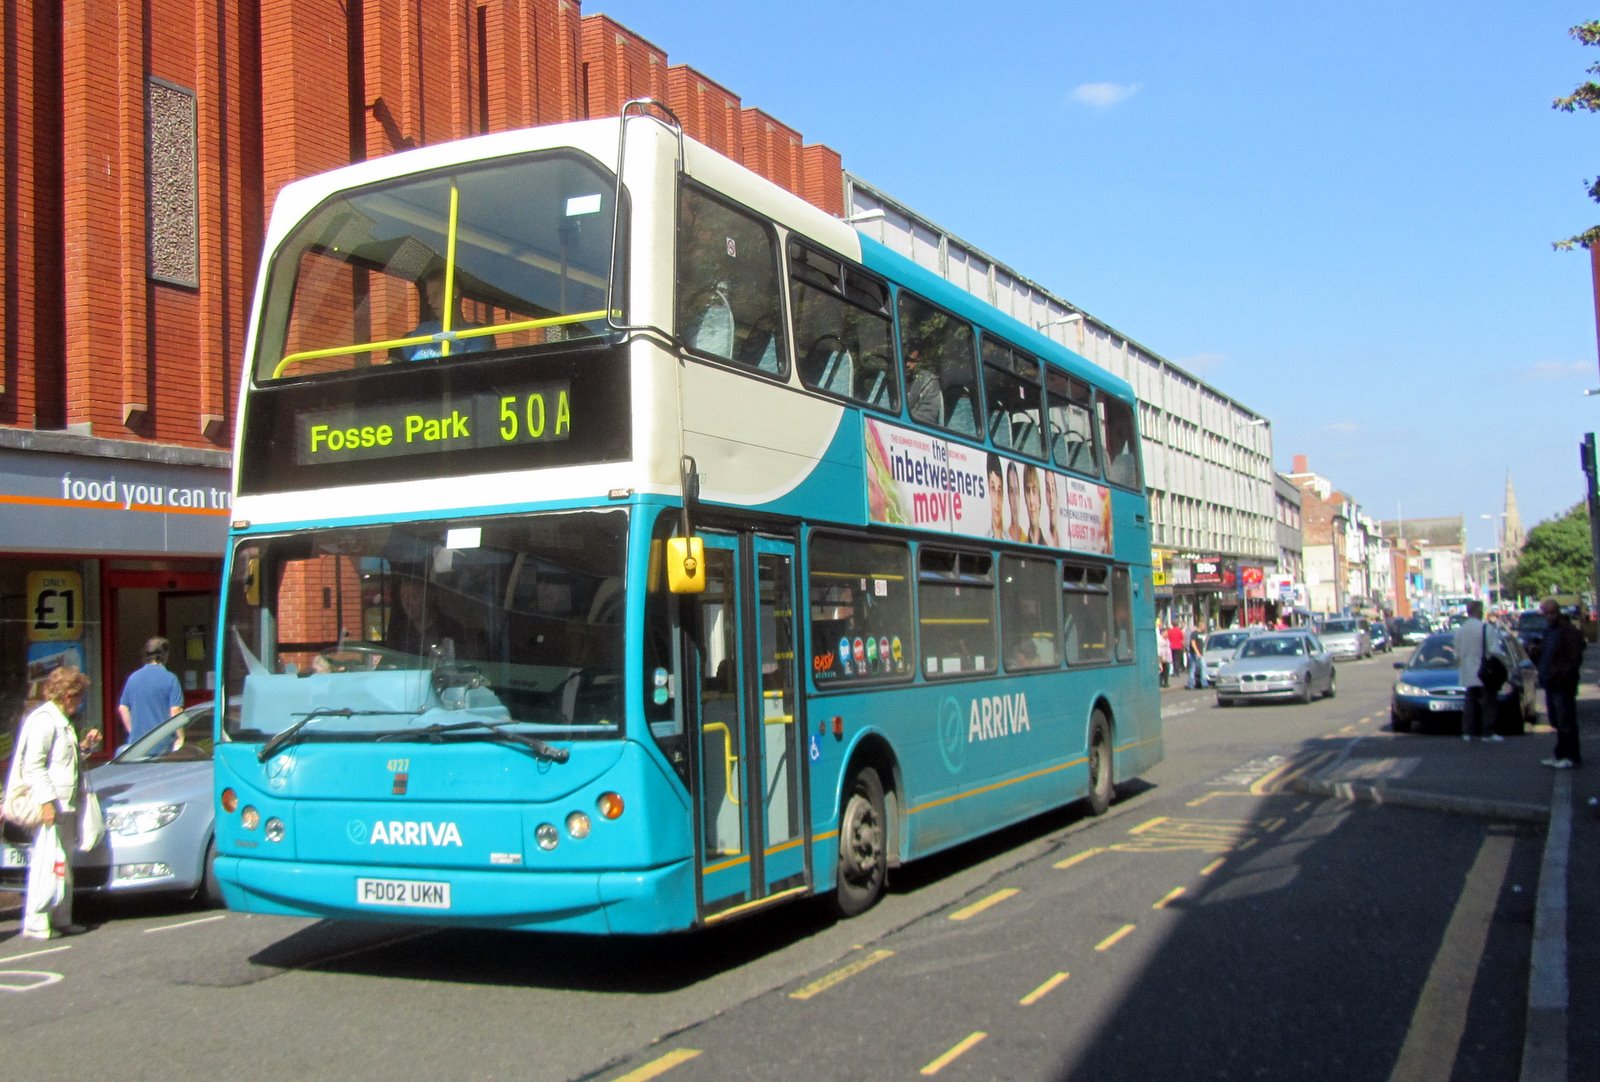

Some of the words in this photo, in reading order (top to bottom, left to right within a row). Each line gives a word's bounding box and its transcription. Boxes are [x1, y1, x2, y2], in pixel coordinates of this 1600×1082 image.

[311, 424, 393, 452] Fosse
[406, 411, 470, 442] Park
[932, 440, 946, 462] the
[890, 446, 985, 499] inbetweeners
[62, 472, 117, 502] food
[122, 484, 163, 510] you
[168, 488, 205, 508] can
[42, 578, 67, 587] ONLY
[34, 589, 74, 629] £1
[813, 651, 834, 671] easy
[968, 692, 1031, 743] ARRIVA
[387, 759, 410, 772] 4727
[370, 821, 463, 847] ARRIVA
[364, 881, 406, 901] FD02
[411, 885, 444, 904] UKN
